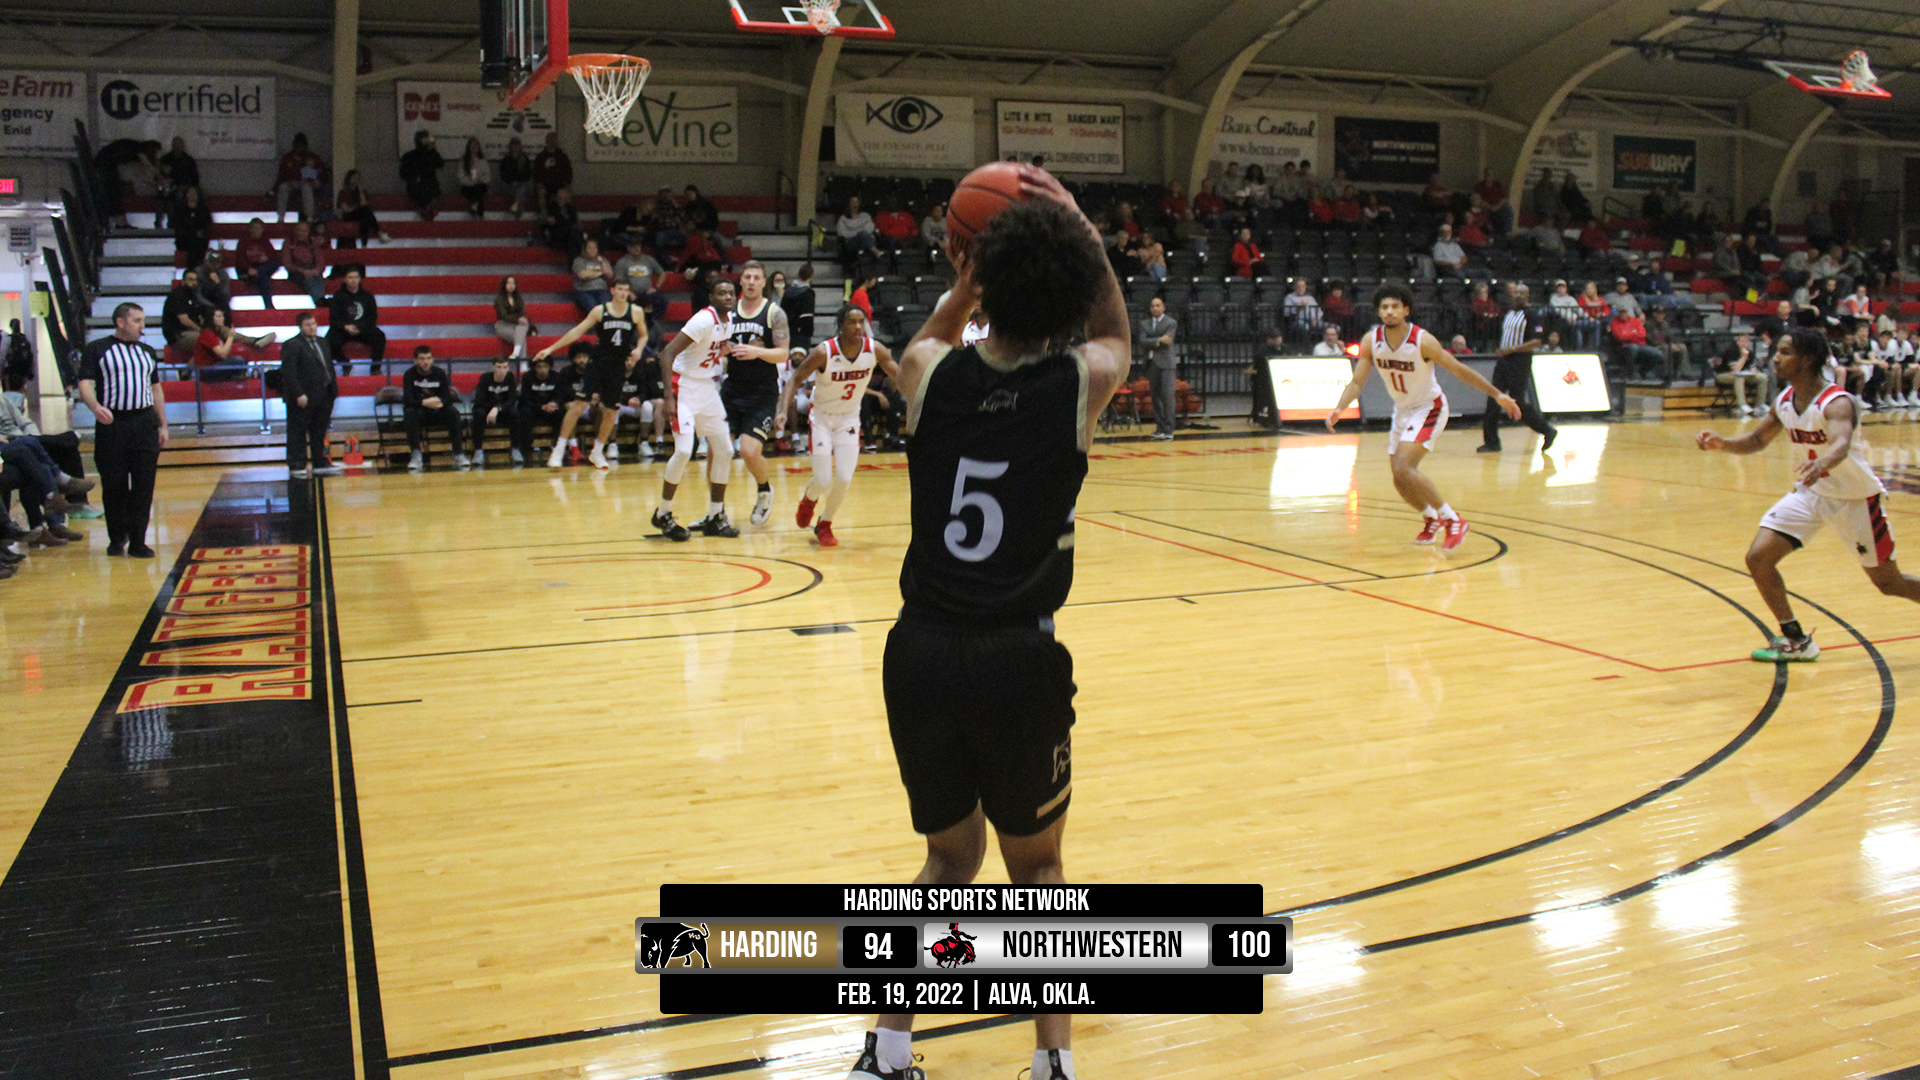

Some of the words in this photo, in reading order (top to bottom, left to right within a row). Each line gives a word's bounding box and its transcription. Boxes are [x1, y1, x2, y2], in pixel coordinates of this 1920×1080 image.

[1256, 115, 1316, 137] Central
[1617, 151, 1693, 173] SUBWAY
[610, 329, 623, 347] 4
[831, 367, 871, 382] RANGERS
[1376, 358, 1415, 372] RANGERS
[841, 383, 857, 401] 3
[1390, 372, 1408, 394] 11
[943, 456, 1010, 563] 5
[116, 545, 312, 715] RANGERS
